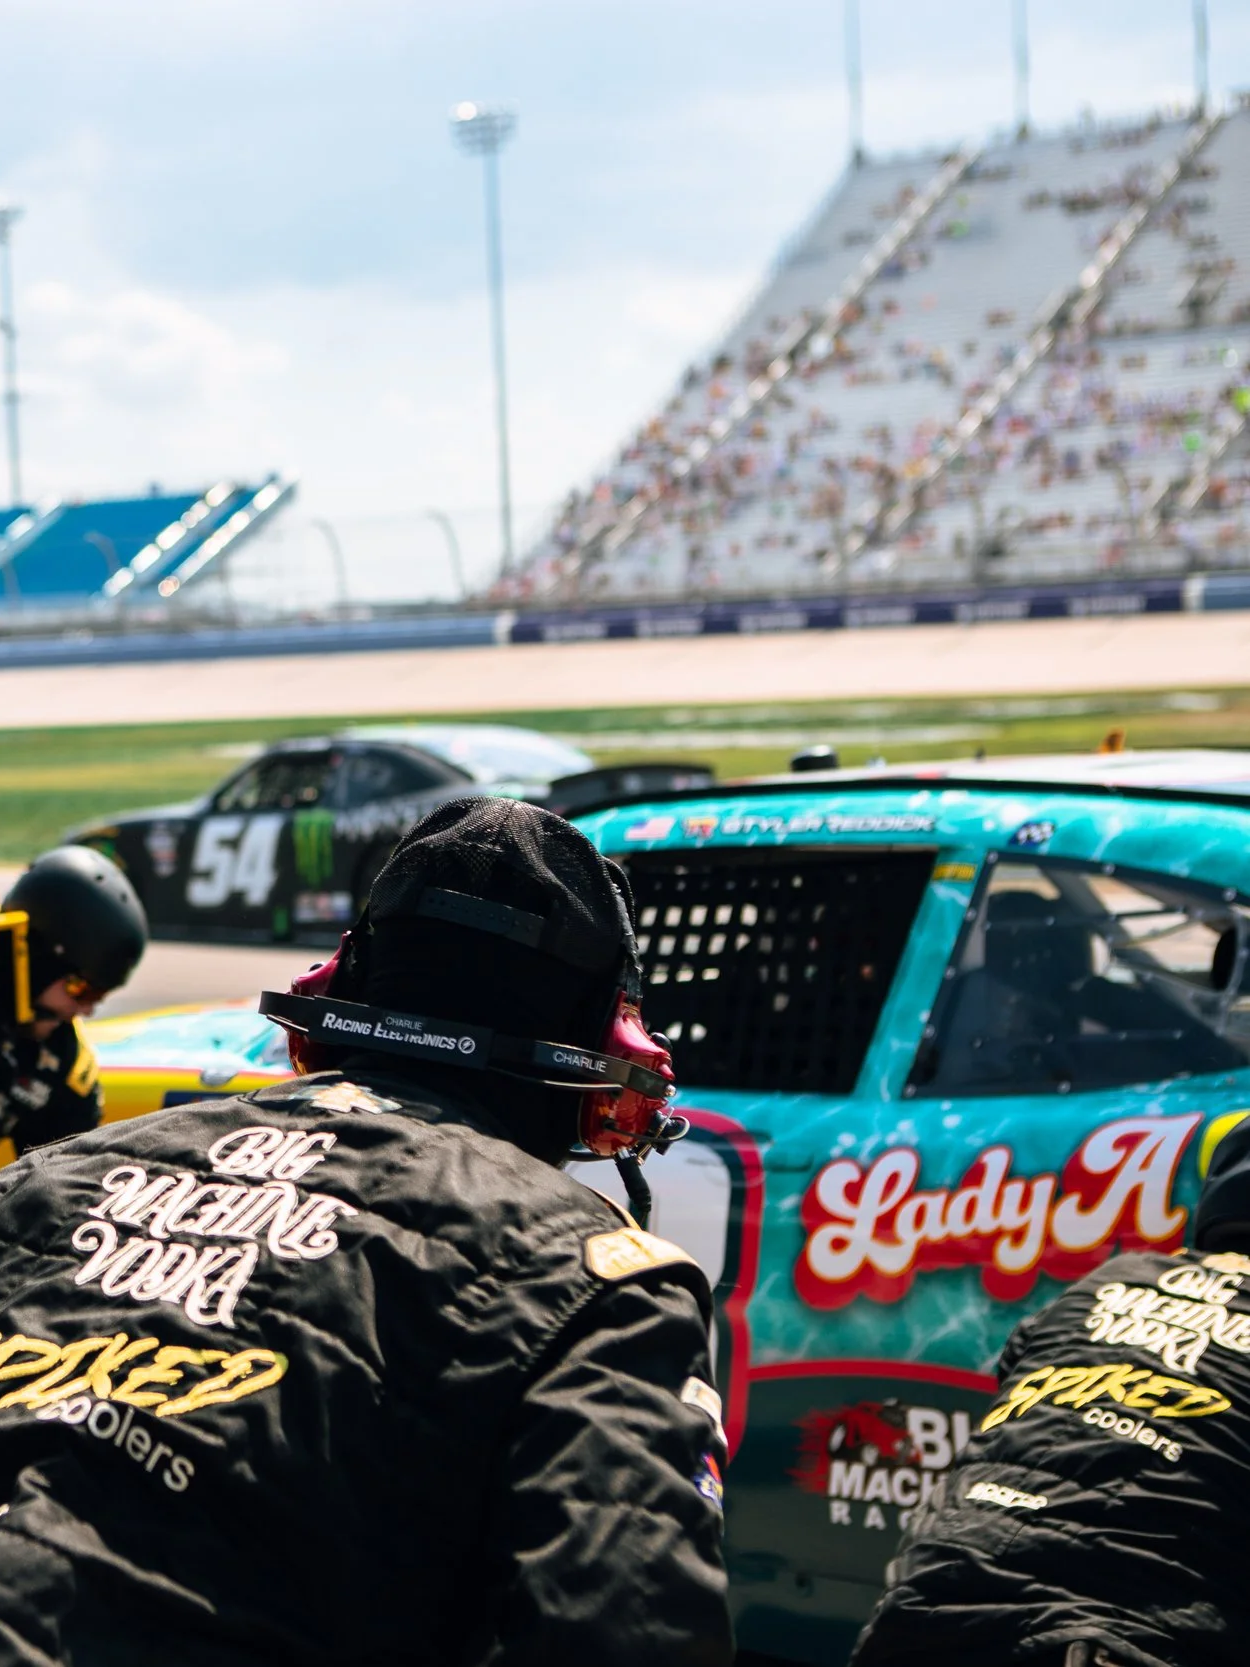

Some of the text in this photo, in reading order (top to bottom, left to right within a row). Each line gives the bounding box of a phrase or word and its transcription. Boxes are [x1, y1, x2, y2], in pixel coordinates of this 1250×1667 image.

[187, 810, 284, 907] 54
[385, 1016, 423, 1031] CHARLIE
[553, 1050, 607, 1073] CHARLIE
[208, 1126, 337, 1181] BIG
[87, 1165, 359, 1261] MACHINE
[804, 1112, 1205, 1283] Lady A
[71, 1220, 259, 1329] VODKA
[1158, 1264, 1245, 1305] BIG
[1084, 1312, 1211, 1376] VODKA
[980, 1363, 1233, 1433] SPIKED
[36, 1396, 195, 1493] coolers
[907, 1407, 970, 1470] BI
[1082, 1407, 1184, 1463] coolers
[828, 1461, 948, 1506] MACH
